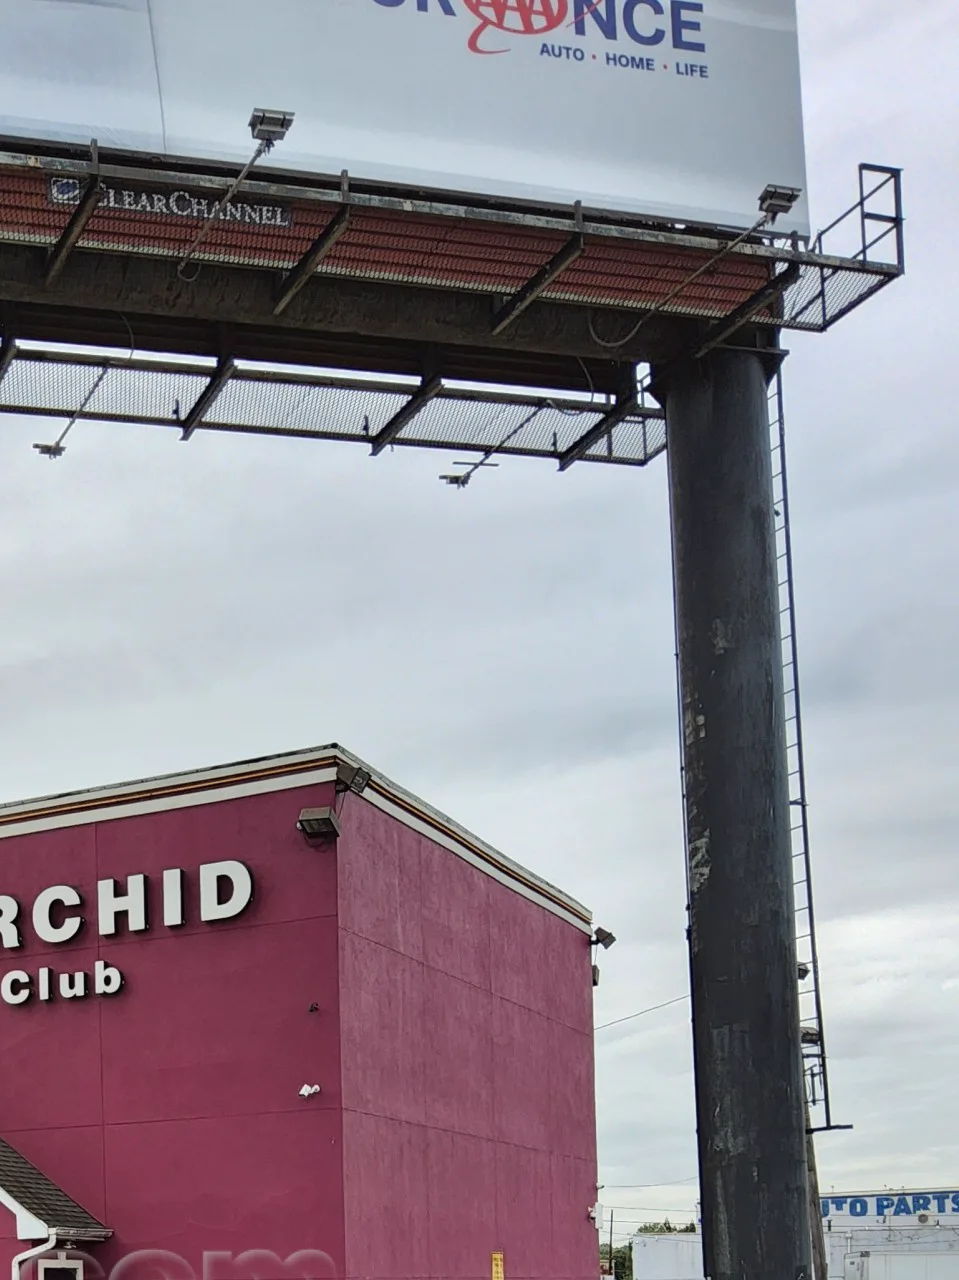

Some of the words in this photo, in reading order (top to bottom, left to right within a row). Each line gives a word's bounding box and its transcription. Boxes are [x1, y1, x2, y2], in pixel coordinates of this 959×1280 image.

[540, 43, 585, 61] AUTO
[605, 53, 655, 71] HOME
[675, 62, 709, 78] LIFE
[0, 960, 123, 1005] Club
